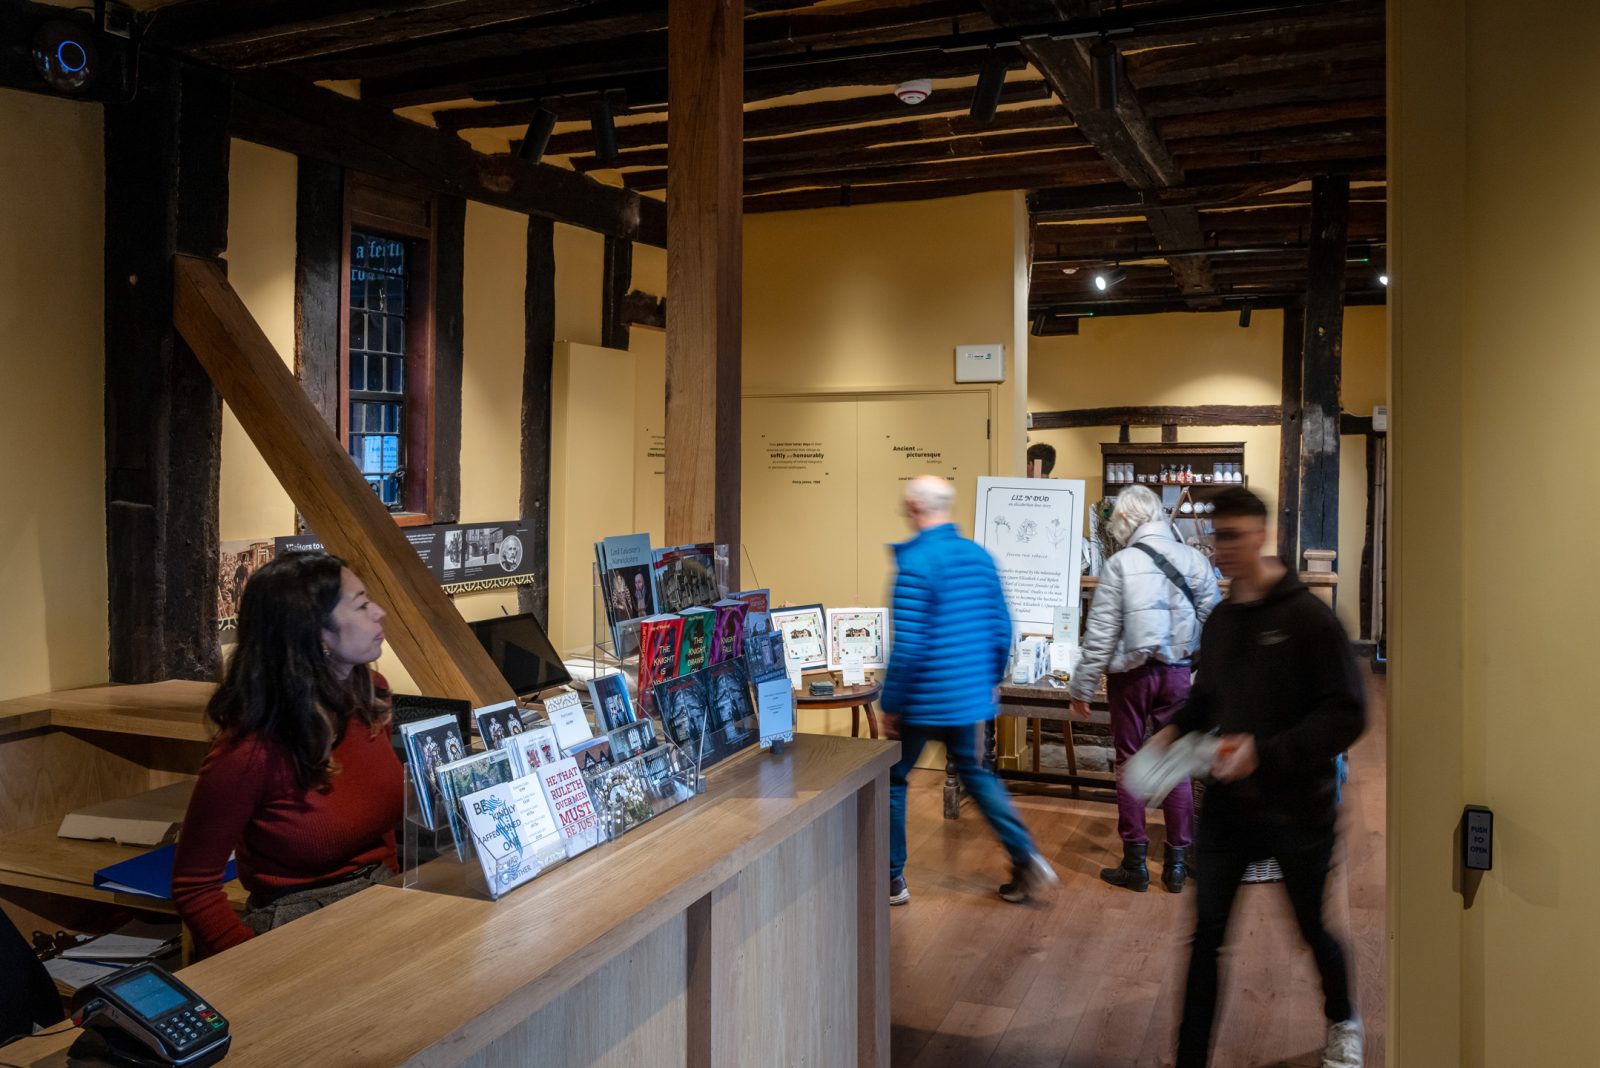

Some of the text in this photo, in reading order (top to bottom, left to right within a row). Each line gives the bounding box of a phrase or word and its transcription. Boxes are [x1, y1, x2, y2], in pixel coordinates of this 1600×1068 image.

[654, 655, 674, 666] KNIGHT
[688, 646, 706, 656] KNIGHT
[546, 767, 578, 787] HE THAT
[550, 778, 584, 800] RULETH
[473, 800, 488, 815] BE
[555, 790, 587, 811] OVER MEN
[493, 804, 516, 821] KINDLY
[559, 801, 592, 826] MUST
[565, 815, 597, 838] BE JUST
